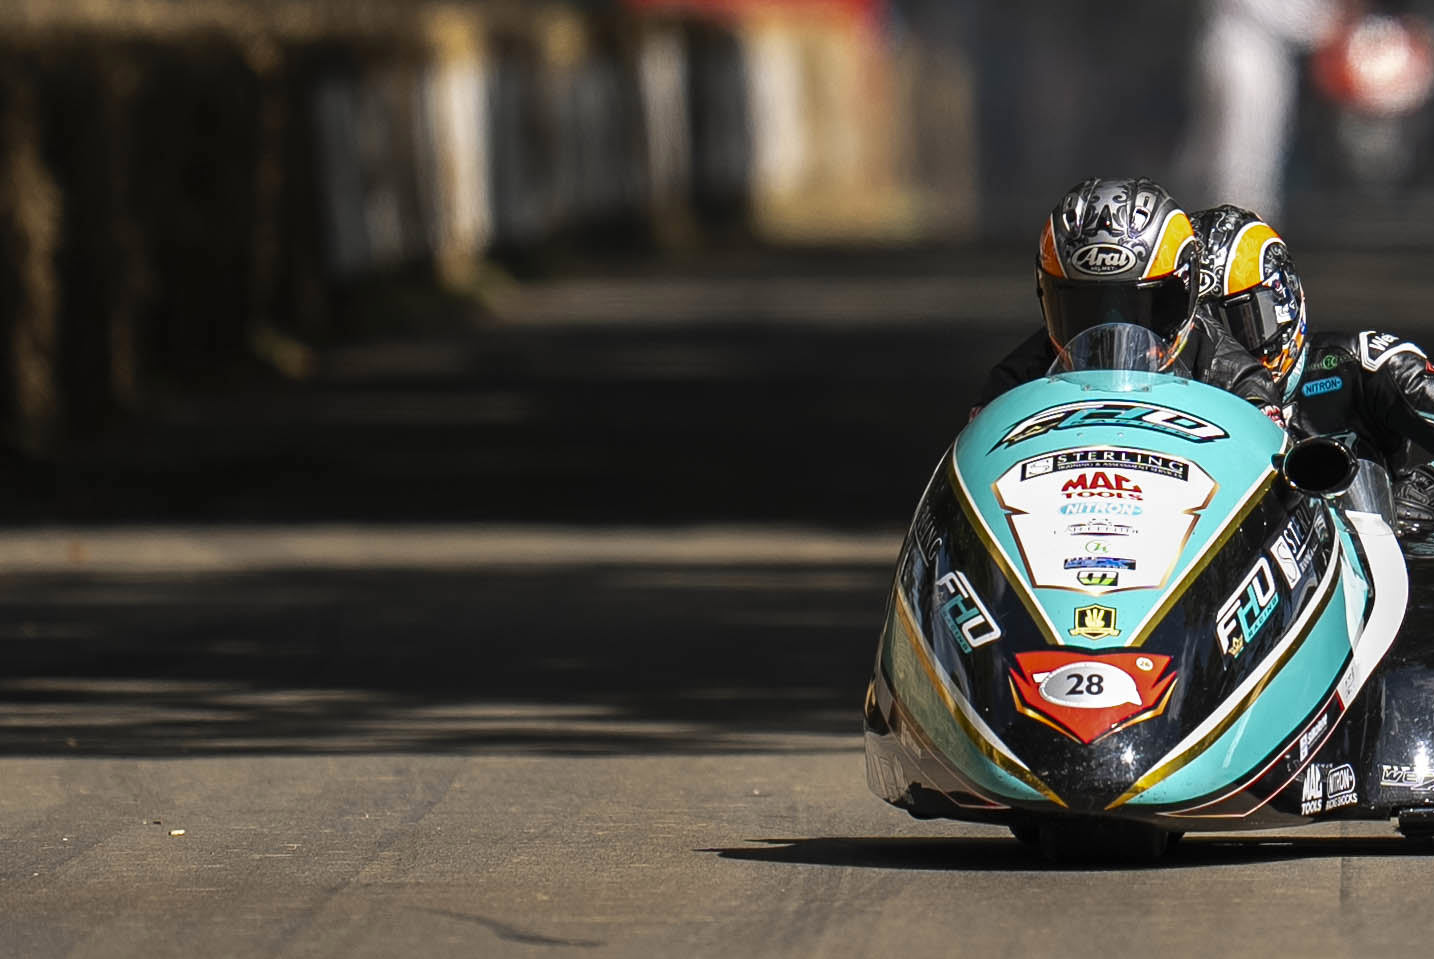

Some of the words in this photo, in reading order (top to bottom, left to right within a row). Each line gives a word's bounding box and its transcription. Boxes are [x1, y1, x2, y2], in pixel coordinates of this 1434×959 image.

[1077, 246, 1129, 266] Arai
[1305, 378, 1339, 395] NITRON
[1058, 451, 1184, 473] STERLING
[1061, 471, 1143, 493] MAC
[1061, 491, 1143, 500] TOOLS
[1065, 502, 1136, 515] NITRON
[1065, 673, 1104, 696] 28
[1302, 763, 1322, 802] MAC
[1301, 798, 1322, 815] TOOLS
